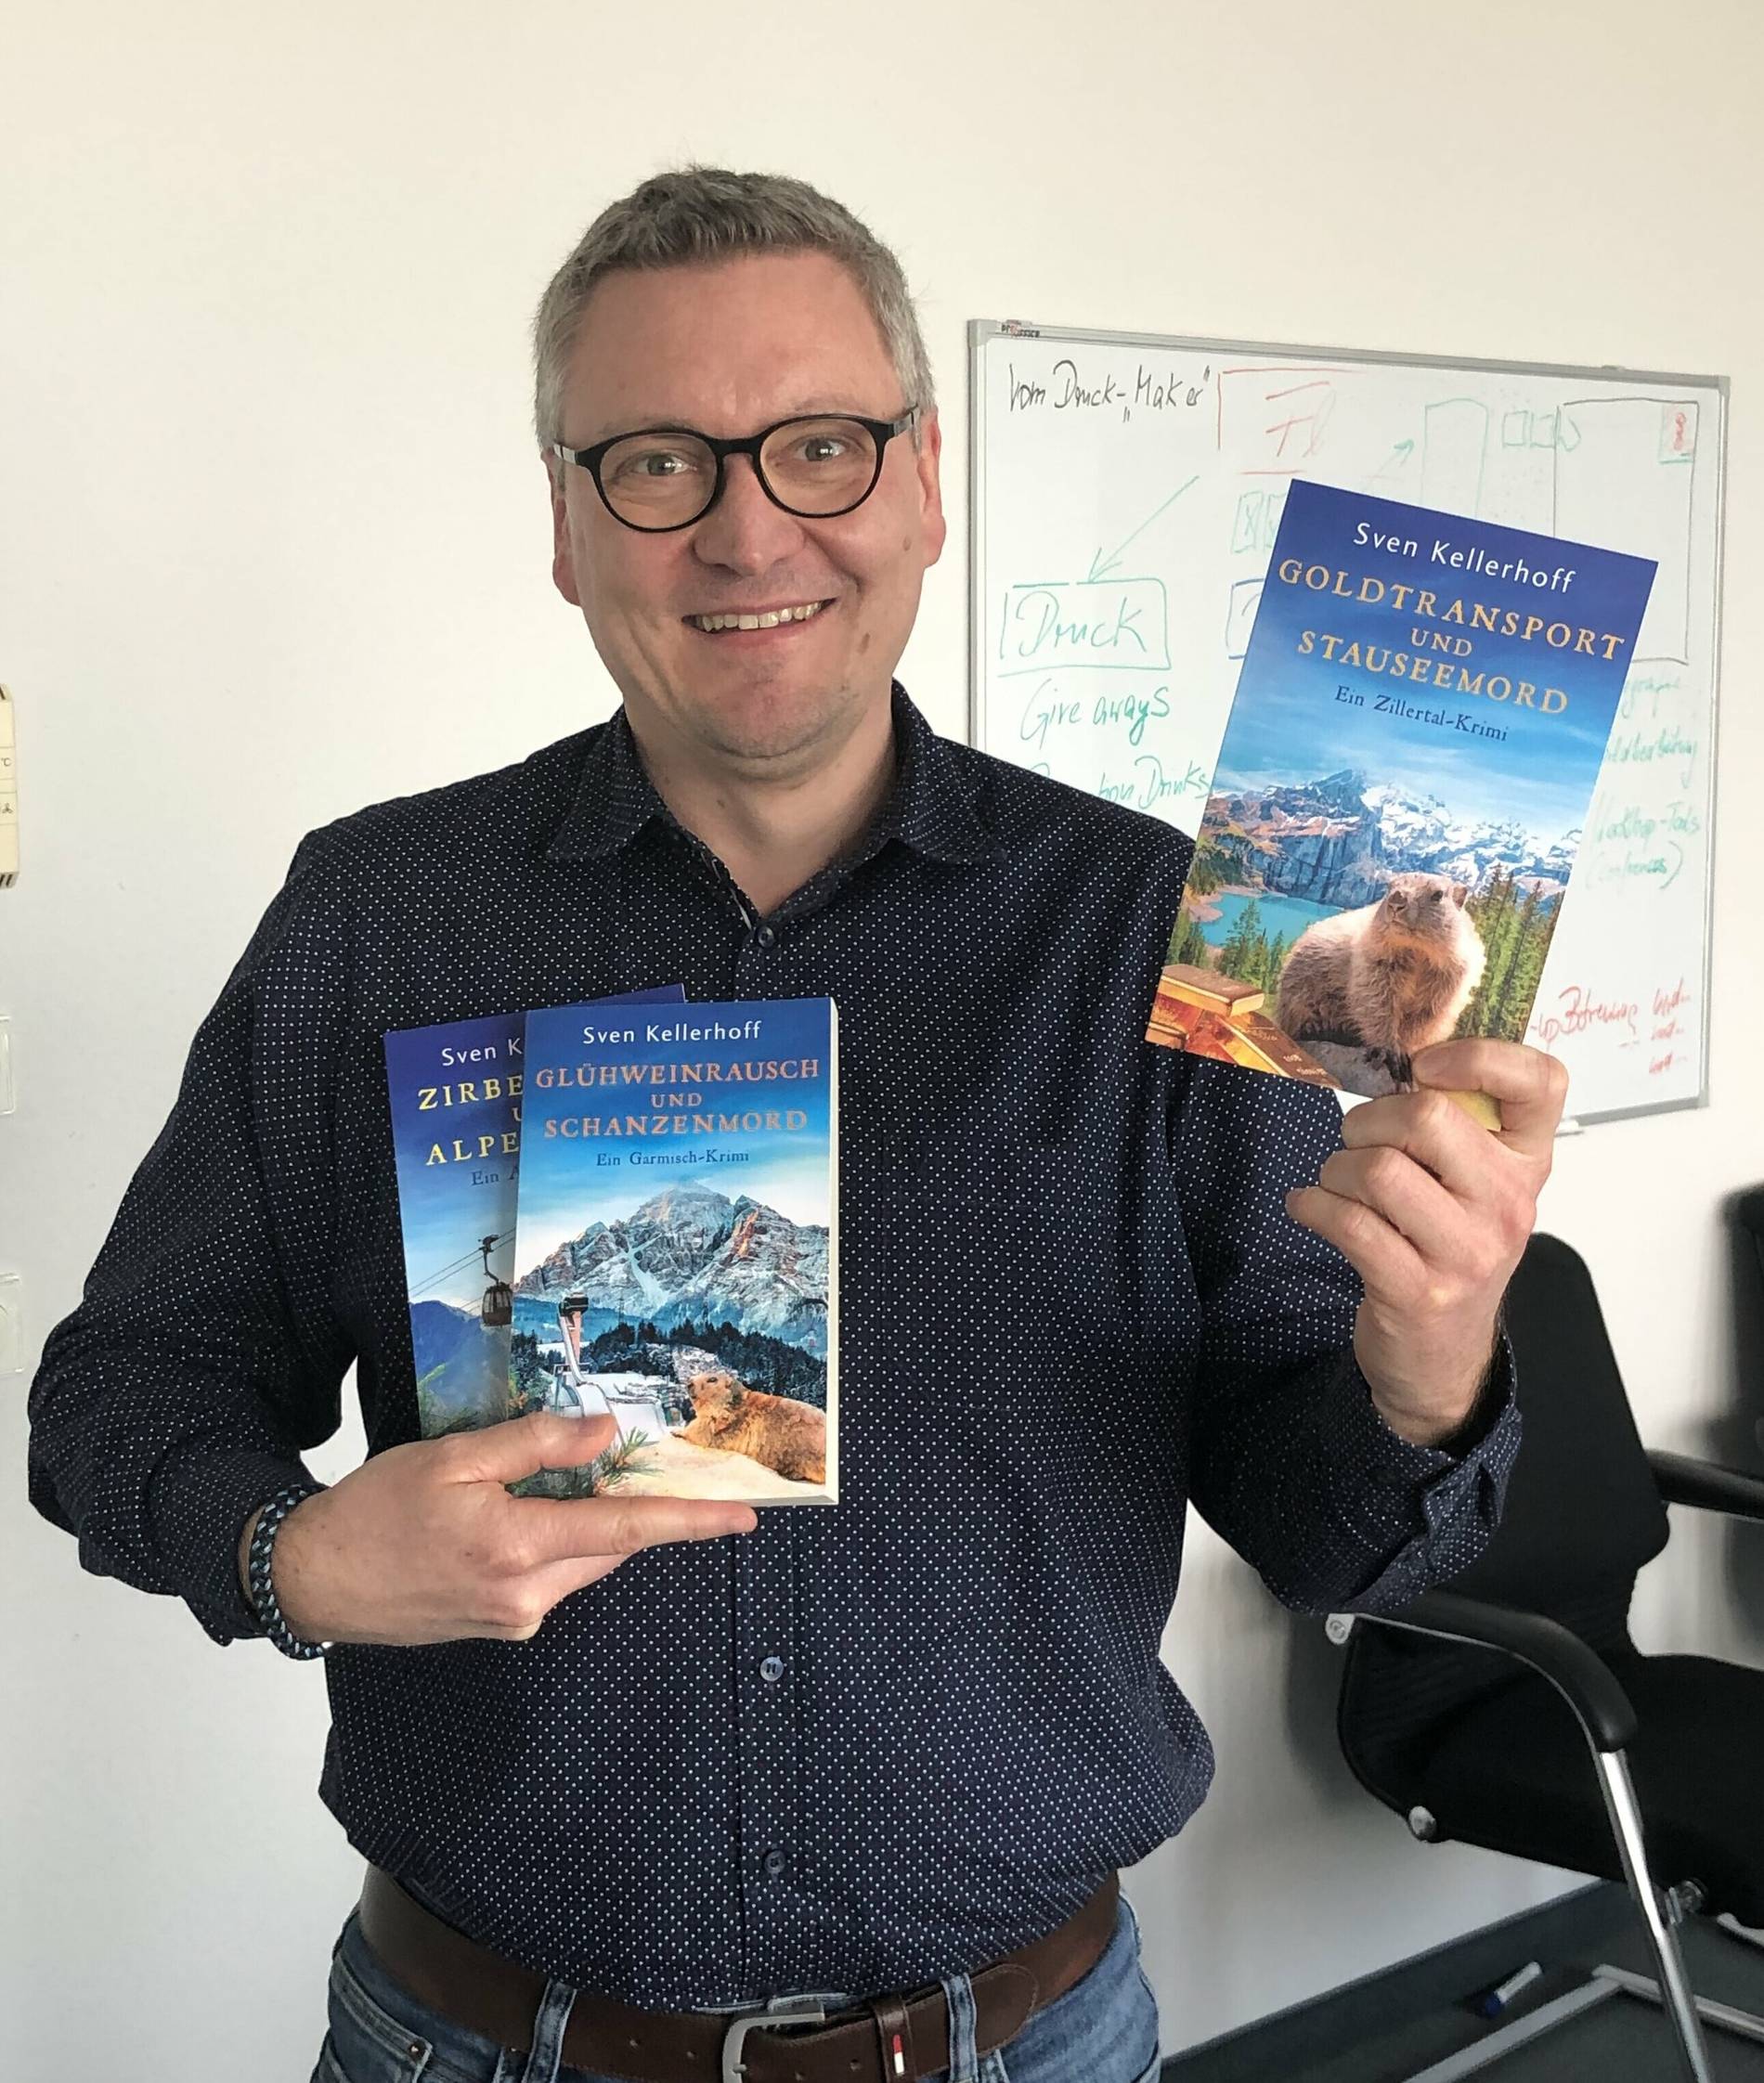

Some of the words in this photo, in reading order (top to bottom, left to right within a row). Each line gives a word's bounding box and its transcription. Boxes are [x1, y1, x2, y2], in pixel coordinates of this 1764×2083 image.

[1353, 522, 1419, 557] Sven
[1430, 539, 1577, 593] Kellerhoff
[1015, 589, 1148, 657] Druck
[1278, 559, 1626, 661] GOLDTRANSPORT
[1409, 627, 1472, 657] UND
[1296, 630, 1569, 715] STAUSEEMORD
[1333, 685, 1365, 706] Ein
[1372, 693, 1509, 742] Zillertal-Krimi
[582, 1026, 635, 1045] Sven
[646, 1020, 761, 1043] Kellerhoff
[441, 1046, 497, 1067] Sven
[536, 1057, 820, 1090] GLÜHWEINRAUSCH
[418, 1074, 524, 1111] ZIRBE
[651, 1092, 703, 1108] UND
[543, 1109, 808, 1139] SCHANZENMORD
[425, 1132, 520, 1166] ALPE
[595, 1152, 621, 1167] Ein
[629, 1148, 750, 1165] Garmisch-Krimi
[471, 1170, 499, 1186] Ein
